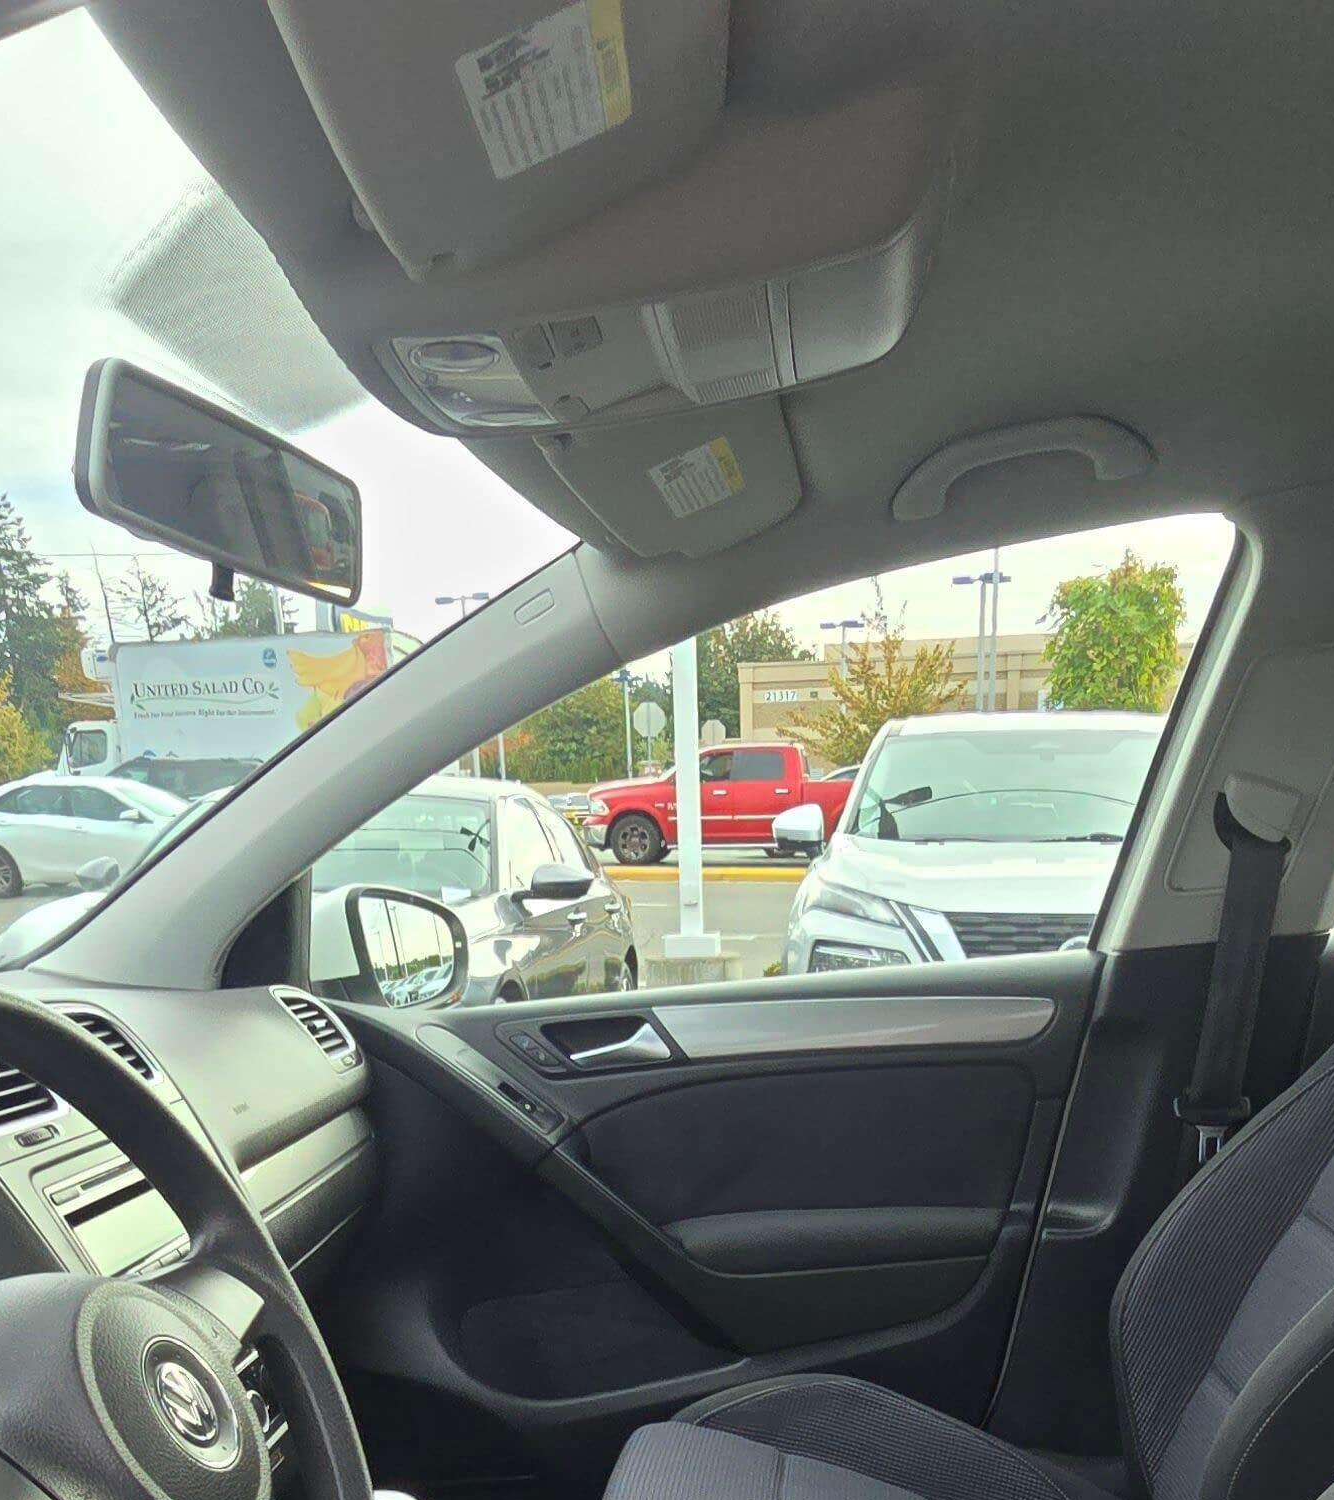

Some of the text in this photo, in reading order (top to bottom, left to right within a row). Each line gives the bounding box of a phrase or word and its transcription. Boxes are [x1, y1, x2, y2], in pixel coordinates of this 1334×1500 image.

[133, 682, 188, 698] UNITED
[192, 680, 238, 696] SALAD
[764, 690, 796, 701] 21317
